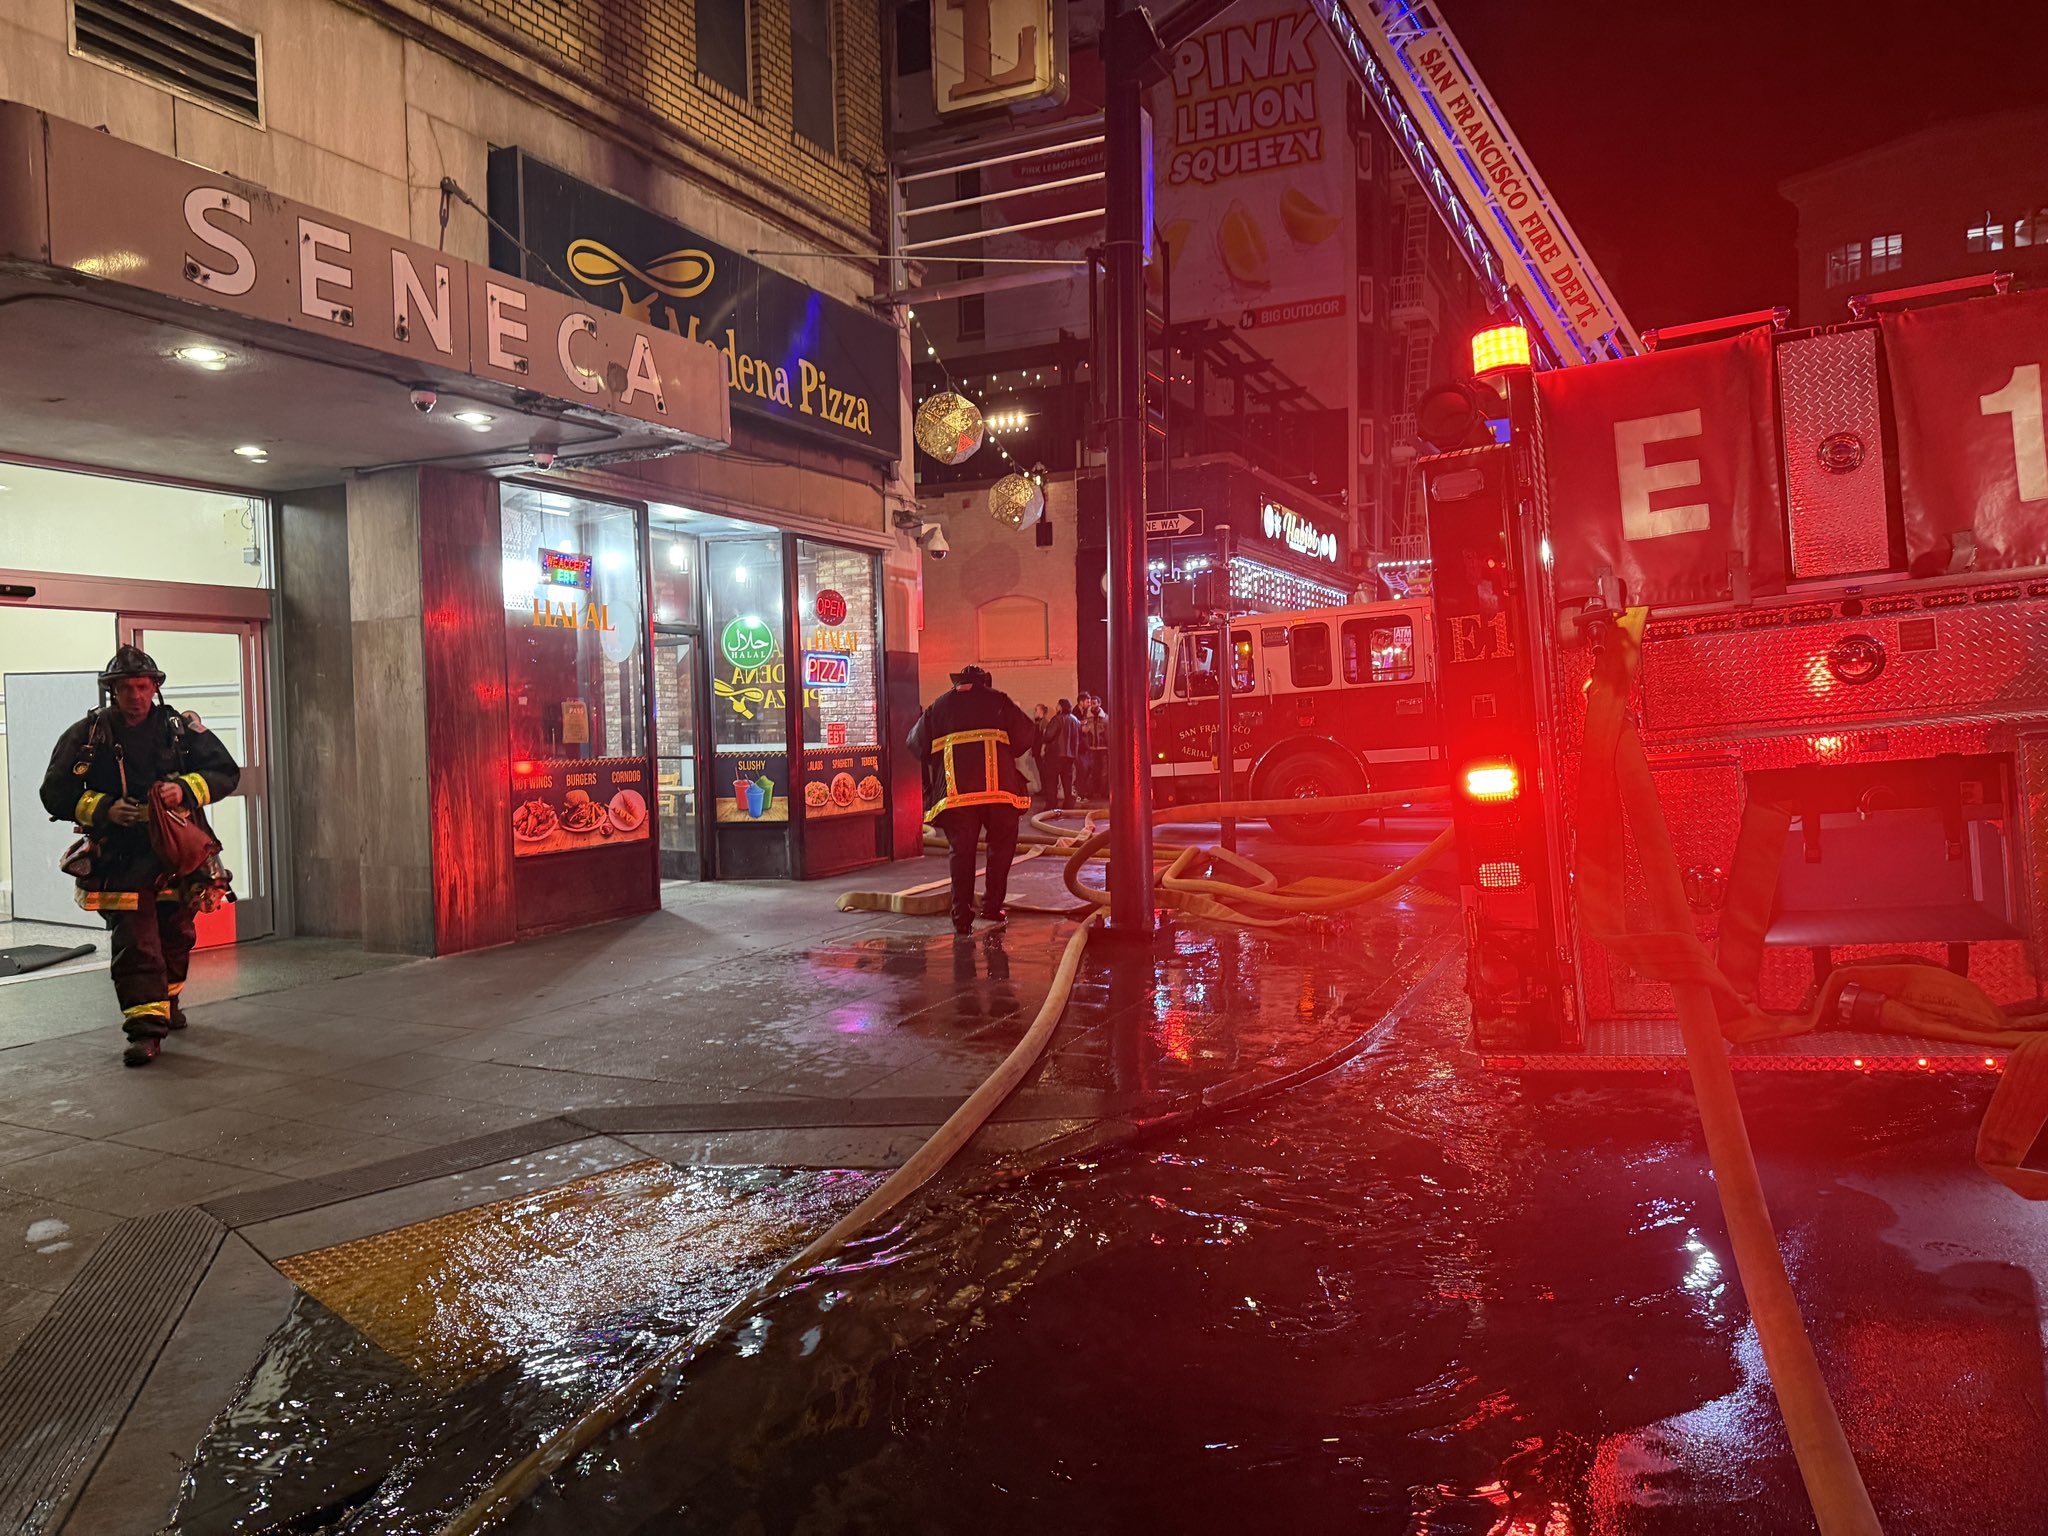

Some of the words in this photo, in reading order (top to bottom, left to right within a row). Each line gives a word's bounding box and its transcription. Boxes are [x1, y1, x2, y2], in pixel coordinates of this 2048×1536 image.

[1172, 11, 1321, 97] PINK
[1175, 80, 1316, 147] LEMON
[1169, 127, 1322, 186] SQUEEZY
[1419, 48, 1458, 94] SAN
[1446, 91, 1528, 210] FRANCISCO
[1518, 211, 1562, 265] FIRE
[1551, 263, 1601, 328] DEPT.
[183, 186, 669, 416] SENECA
[1261, 309, 1280, 324] BIG
[1282, 300, 1340, 320] OUTDOOR
[798, 358, 872, 435] Pizza
[1979, 363, 2048, 503] 1
[1613, 407, 1711, 542] E
[1146, 521, 1157, 531] NE
[1161, 519, 1180, 529] WAY
[545, 555, 559, 568] WE
[559, 557, 589, 573] ACCEPT
[556, 569, 577, 584] EBT
[533, 598, 615, 631] HALAL
[817, 597, 845, 618] OPEN
[728, 628, 769, 652] حلال
[815, 628, 860, 652] HALAL
[1395, 628, 1411, 638] ATM
[1446, 610, 1515, 664] E1
[731, 651, 766, 659] HALAL
[807, 658, 847, 683] PIZZA
[828, 730, 845, 744] EBT
[1179, 728, 1197, 740] SAN
[1200, 723, 1251, 735] FRASCO
[1181, 745, 1210, 758] AERIAL
[737, 760, 766, 771] SLUSHY
[832, 757, 854, 769] SPAGHETTI
[529, 775, 553, 790] WINGS
[566, 773, 597, 787] BURGERS
[611, 770, 641, 784] CORNDOG
